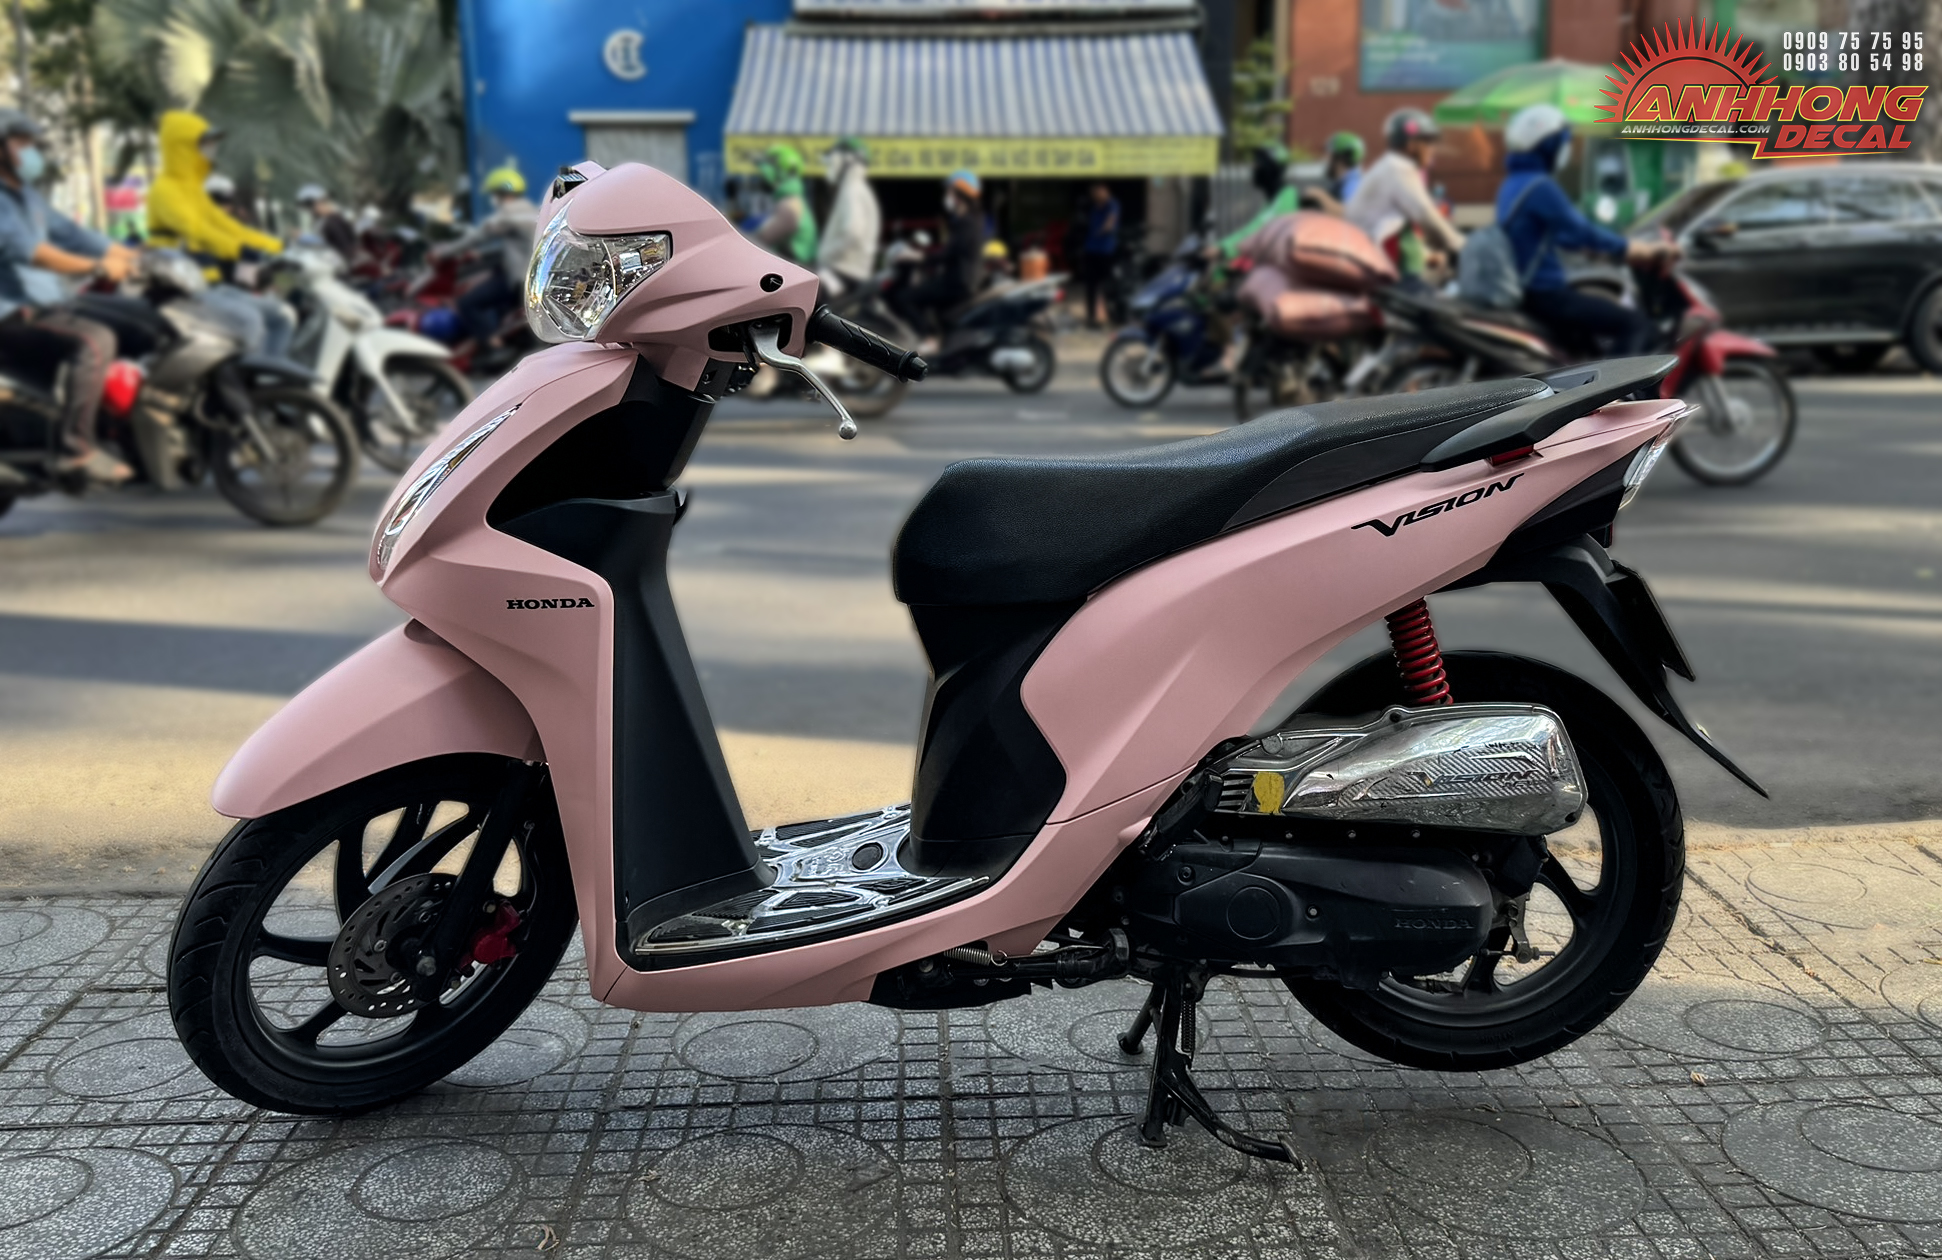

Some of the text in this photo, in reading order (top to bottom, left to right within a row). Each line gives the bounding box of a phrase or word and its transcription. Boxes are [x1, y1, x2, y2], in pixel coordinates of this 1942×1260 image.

[1351, 473, 1525, 537] VISION
[506, 598, 595, 609] HONDA
[1395, 919, 1475, 930] HONDA
